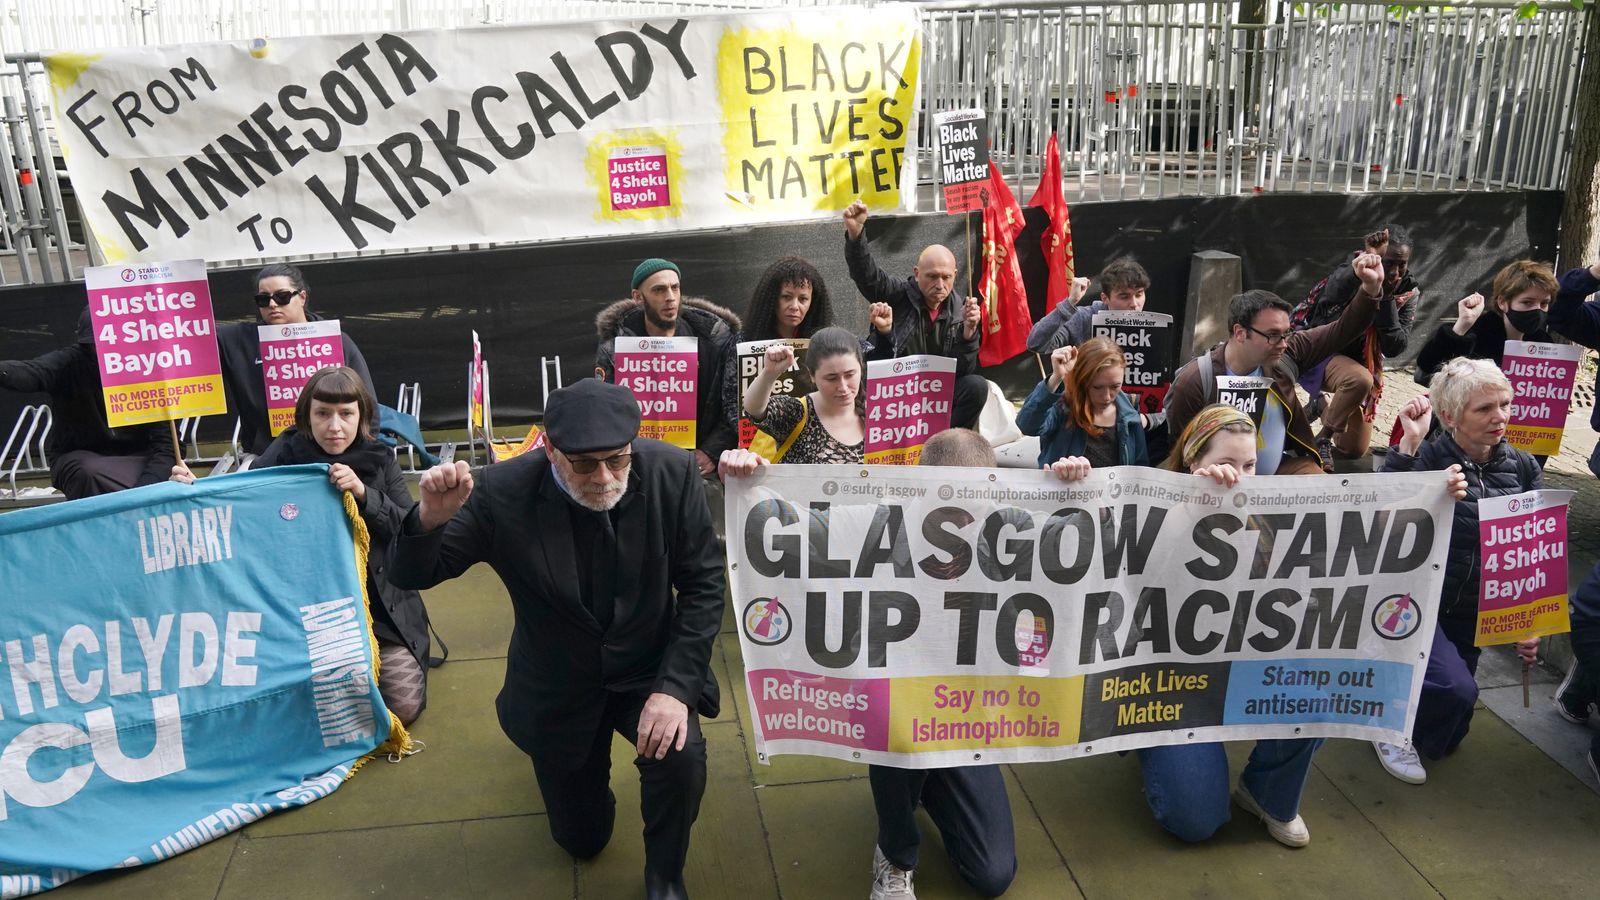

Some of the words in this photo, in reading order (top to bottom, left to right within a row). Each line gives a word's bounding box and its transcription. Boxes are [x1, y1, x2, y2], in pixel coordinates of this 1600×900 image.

[743, 41, 908, 95] BLACK
[67, 57, 217, 158] FROM
[750, 97, 904, 148] LIVES
[940, 122, 978, 145] Black
[102, 33, 438, 252] MINNESOTA
[305, 19, 698, 250] KIRKCALDY
[942, 145, 976, 164] Lives
[610, 158, 660, 174] Justice
[943, 162, 988, 184] Matter
[611, 177, 620, 189] 4
[622, 174, 667, 188] Sheku
[613, 189, 657, 205] Bayoh
[95, 288, 196, 317] Justice
[99, 324, 118, 345] 4
[121, 315, 211, 343] Sheku
[1105, 317, 1132, 326] Socialist
[1132, 318, 1156, 326] Worker
[103, 344, 192, 376] Bayoh
[264, 340, 333, 361] Justice
[266, 366, 279, 380] 4
[281, 361, 342, 380] She
[618, 355, 688, 373] Justice
[742, 356, 800, 377] Blk
[1504, 360, 1566, 379] Justice
[633, 376, 694, 393] Sheku
[1125, 367, 1162, 385] tter
[1228, 380, 1249, 388] Socialis
[109, 392, 128, 403] NO
[130, 388, 165, 400] MORE
[167, 382, 214, 396] DEATHS
[269, 385, 305, 403] Bay
[870, 375, 943, 401] Justice
[1515, 381, 1569, 400] Sheku
[111, 403, 124, 413] IN
[126, 396, 181, 411] CUSTODY
[637, 396, 678, 416] yoh
[869, 406, 881, 421] 4
[885, 397, 949, 420] Sheku
[1220, 392, 1258, 412] Black
[1510, 402, 1551, 420] ayoh
[273, 420, 282, 428] IN
[640, 425, 656, 433] ORE
[657, 425, 689, 433] DEATHS
[869, 419, 929, 444] Bayoh
[1505, 429, 1527, 438] MORE
[1529, 431, 1556, 440] DEATHS
[640, 432, 665, 440] STODY
[1508, 437, 1534, 445] STODY
[882, 453, 906, 462] MORE
[908, 450, 921, 459] DEA
[840, 482, 927, 498] @sutrglasgow
[956, 486, 1104, 503] standuptoracismglasgow
[1124, 483, 1224, 508] @AntiRacismDay
[1250, 490, 1378, 507] standuptoracism.org.uk
[137, 504, 233, 574] LIBRARY
[744, 498, 1168, 585] GLASGOW
[1185, 507, 1435, 581] STAND
[1484, 515, 1556, 547] Justice
[1484, 553, 1498, 573] 4
[1503, 540, 1564, 571] Sheku
[1484, 567, 1546, 600] Bayoh
[804, 590, 921, 669] UP
[943, 591, 1055, 668] TO
[1078, 584, 1369, 666] RACISM
[1481, 616, 1497, 626] NO
[1500, 611, 1526, 624] MORE
[1480, 626, 1491, 635] IN
[0, 611, 262, 720] HCLYDE
[299, 596, 376, 748] ADMINISTRATIVE
[1101, 675, 1151, 702] Black
[1156, 669, 1209, 693] Lives
[1262, 665, 1331, 690] Stamp
[1337, 667, 1375, 688] out
[763, 677, 869, 711] Refugees
[934, 683, 975, 713] Say
[981, 689, 1010, 707] no
[1018, 684, 1041, 707] to
[1244, 692, 1385, 718] antisemitism
[764, 708, 866, 740] welcome
[1117, 701, 1183, 727] Matter
[912, 714, 1060, 744] Islamophobia
